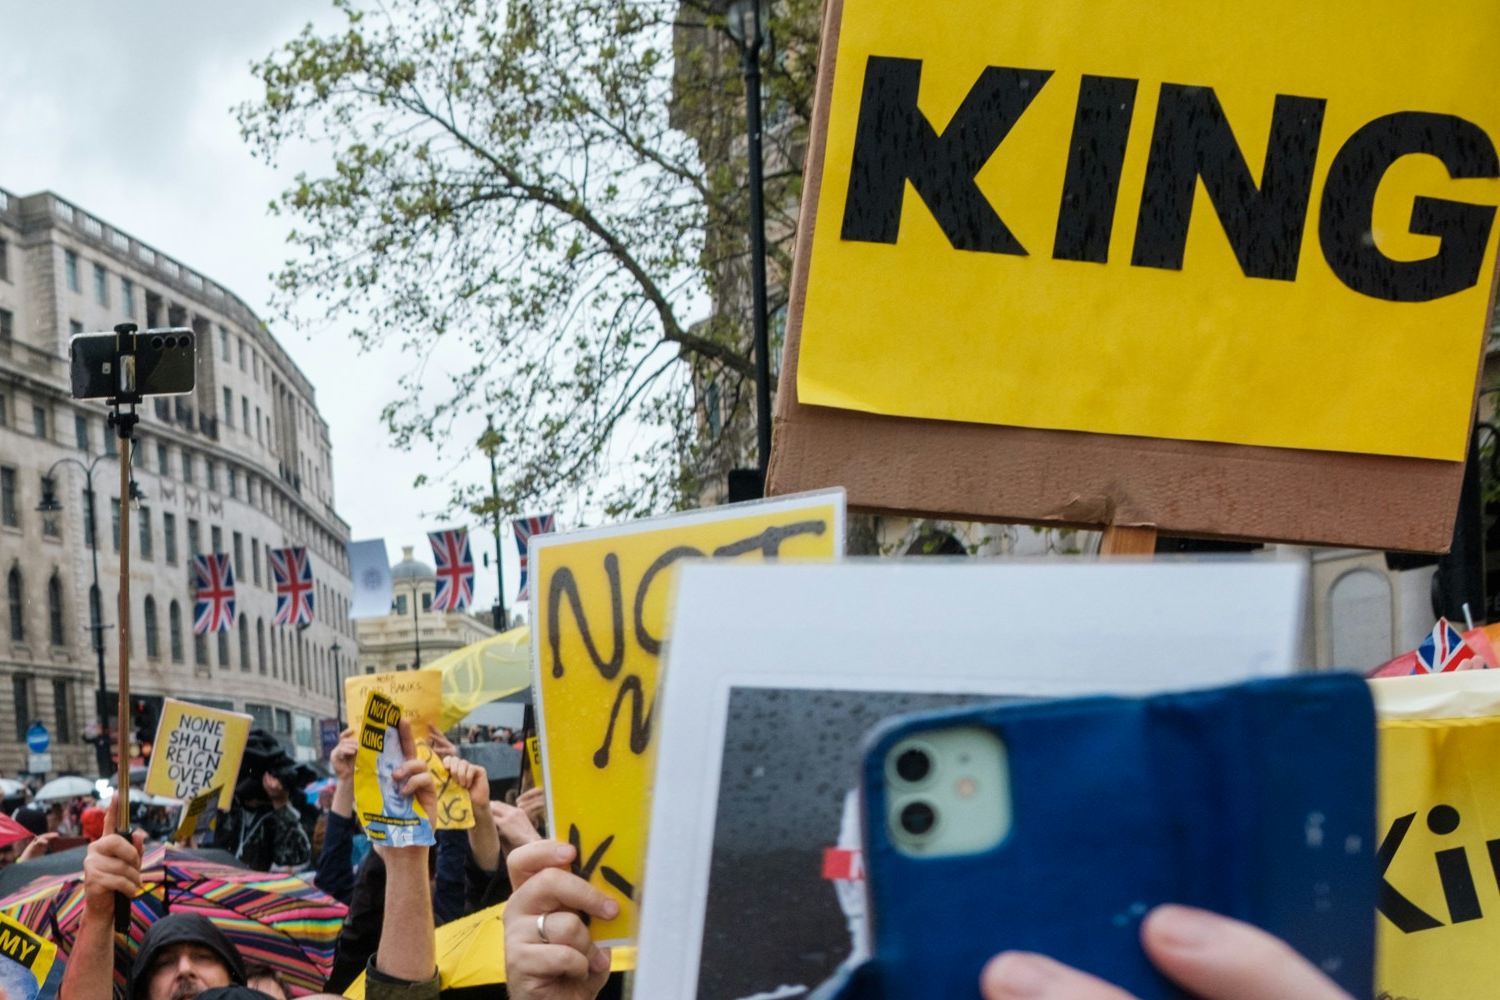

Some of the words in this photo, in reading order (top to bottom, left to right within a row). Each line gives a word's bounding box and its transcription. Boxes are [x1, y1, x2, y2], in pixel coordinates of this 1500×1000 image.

[841, 55, 1500, 302] KING
[180, 714, 225, 736] NONE
[369, 699, 388, 719] NOT
[387, 708, 401, 727] MY
[169, 730, 223, 755] SHALL
[362, 730, 383, 750] KING
[166, 746, 221, 770] REIGN
[168, 764, 214, 788] OVER
[176, 784, 199, 800] US
